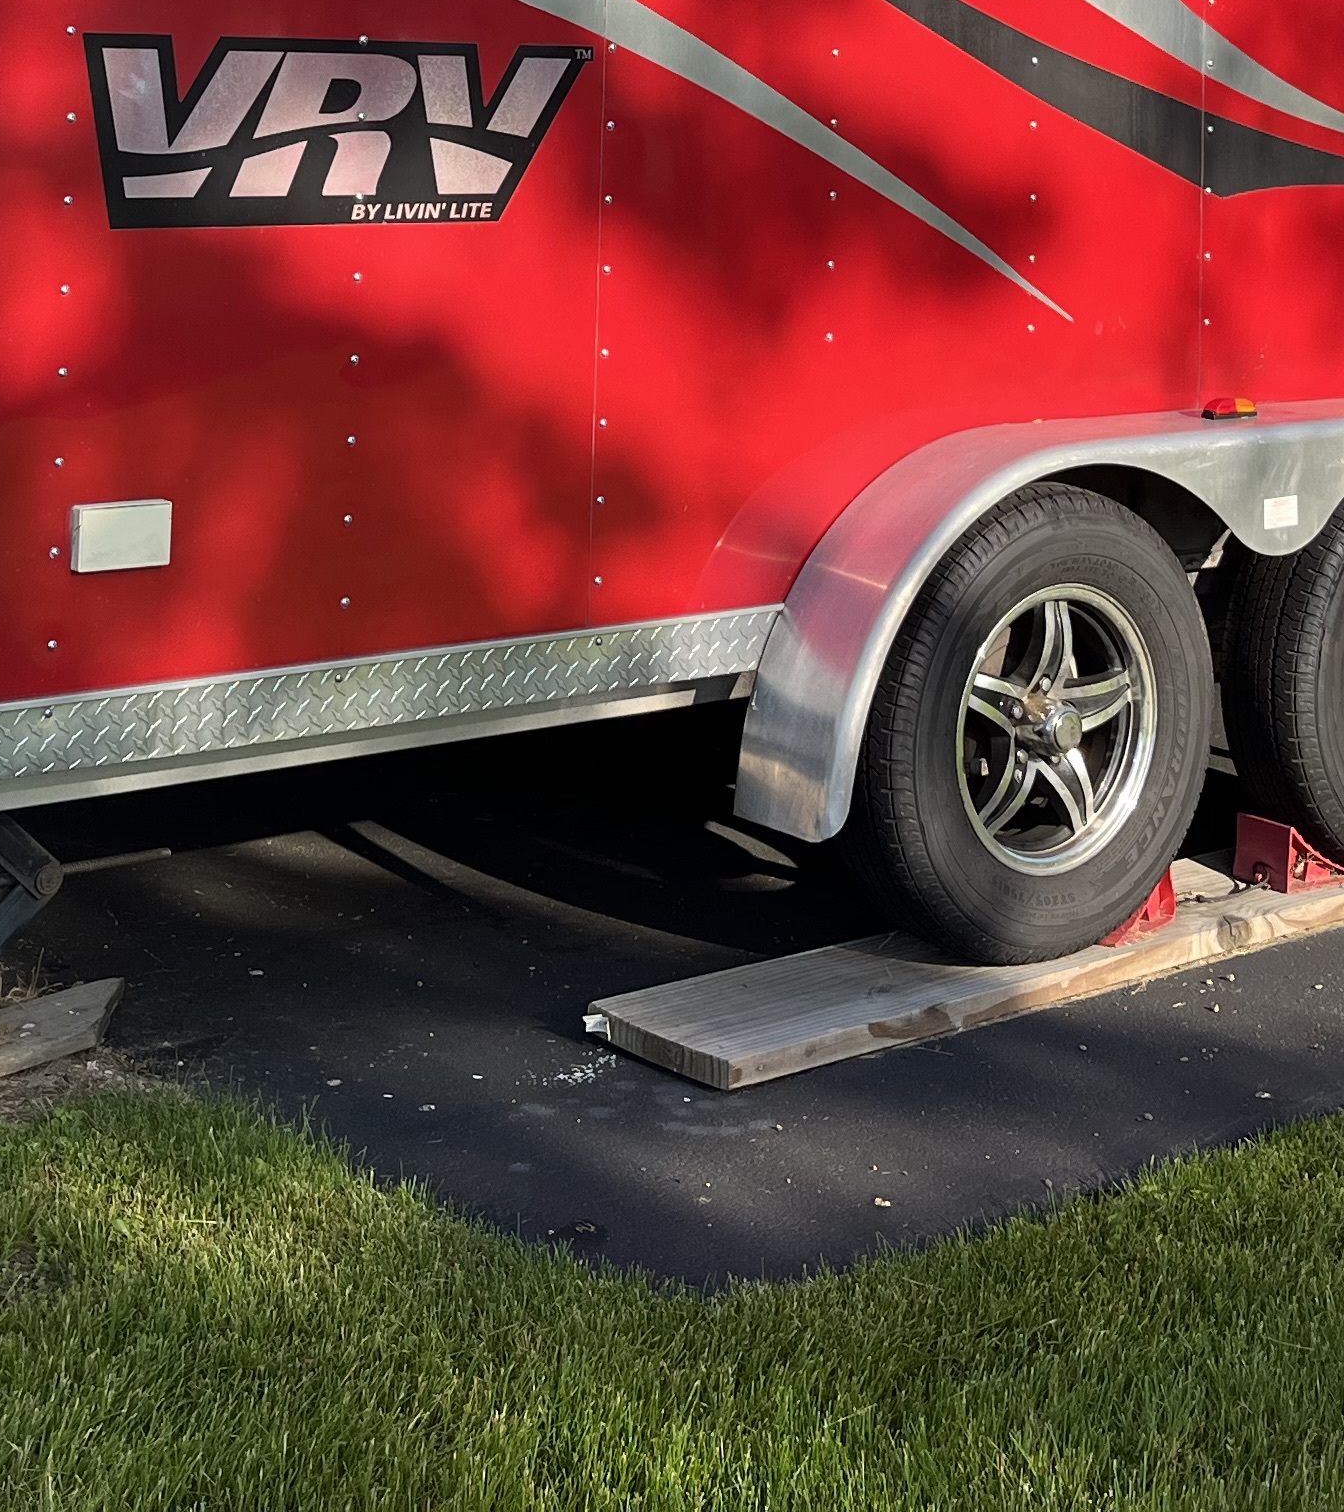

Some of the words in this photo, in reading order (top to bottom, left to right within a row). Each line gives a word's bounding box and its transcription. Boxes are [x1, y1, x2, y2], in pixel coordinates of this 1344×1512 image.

[101, 47, 573, 199] VRV
[351, 204, 381, 220] BY
[383, 203, 447, 220] LIVIN'
[449, 202, 493, 218] LITE
[1124, 645, 1192, 871] ENDURANCE
